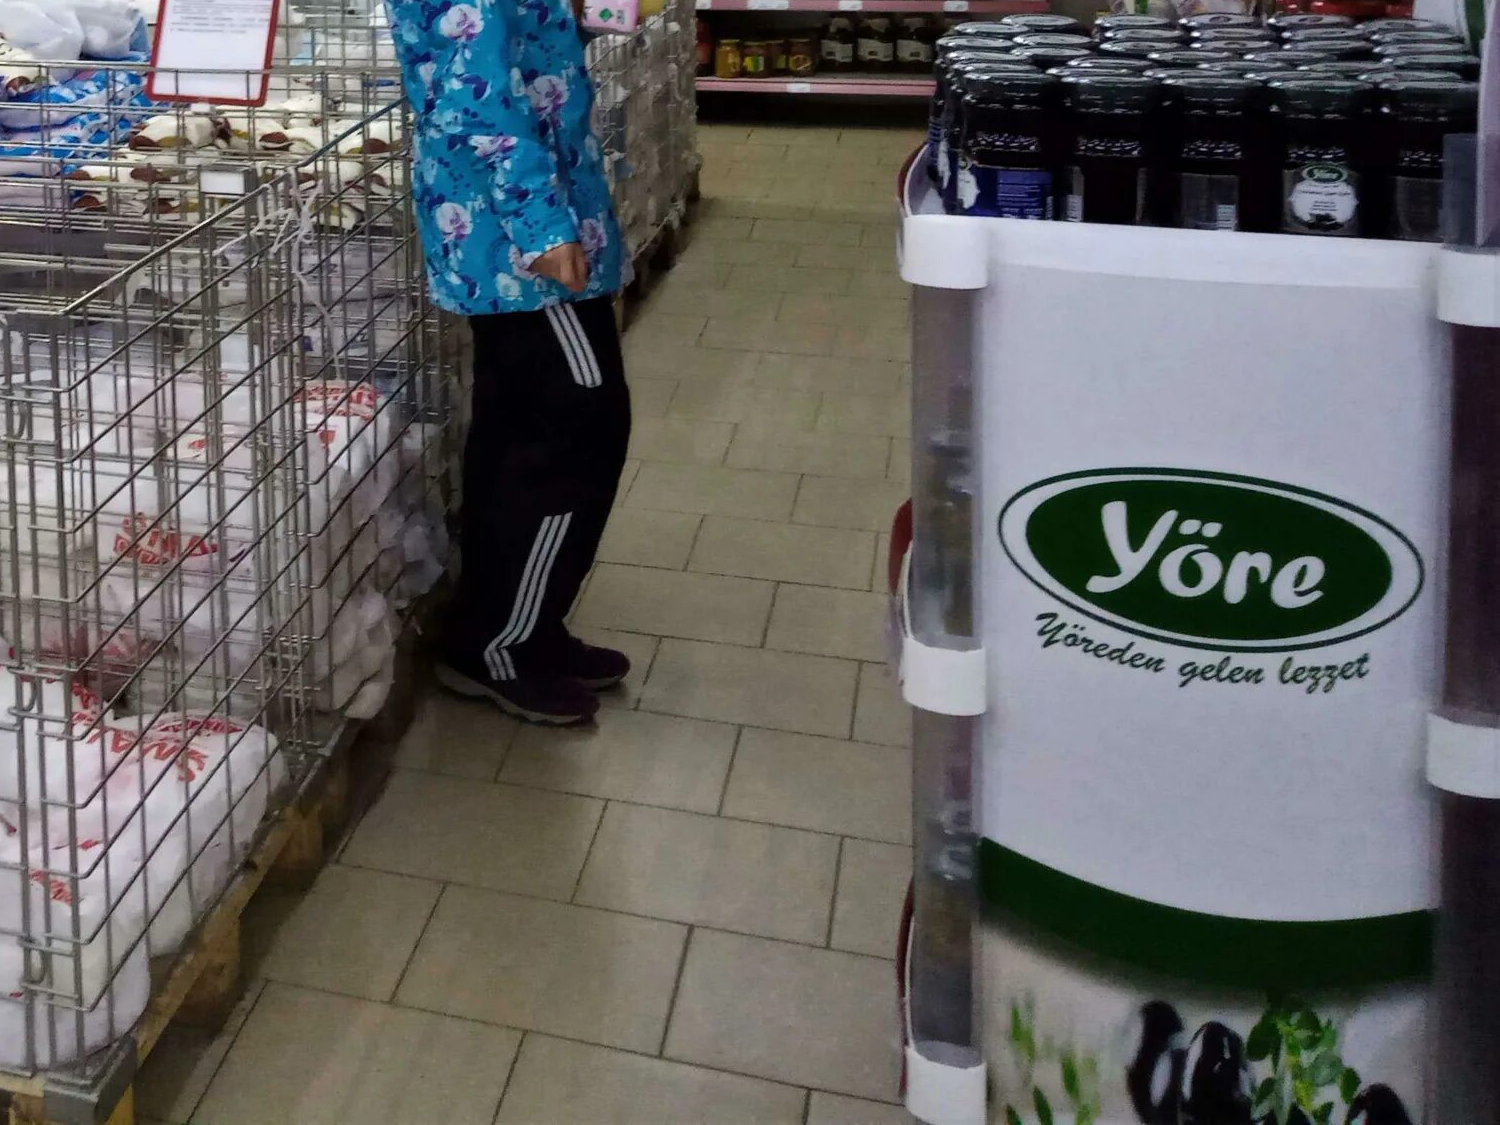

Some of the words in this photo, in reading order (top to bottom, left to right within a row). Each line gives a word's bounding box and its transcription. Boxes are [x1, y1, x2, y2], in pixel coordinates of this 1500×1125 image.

[1085, 500, 1327, 610] Yöre
[1034, 610, 1168, 673] Yöreden
[1178, 655, 1266, 689] gelen
[1278, 651, 1372, 695] lezzet
